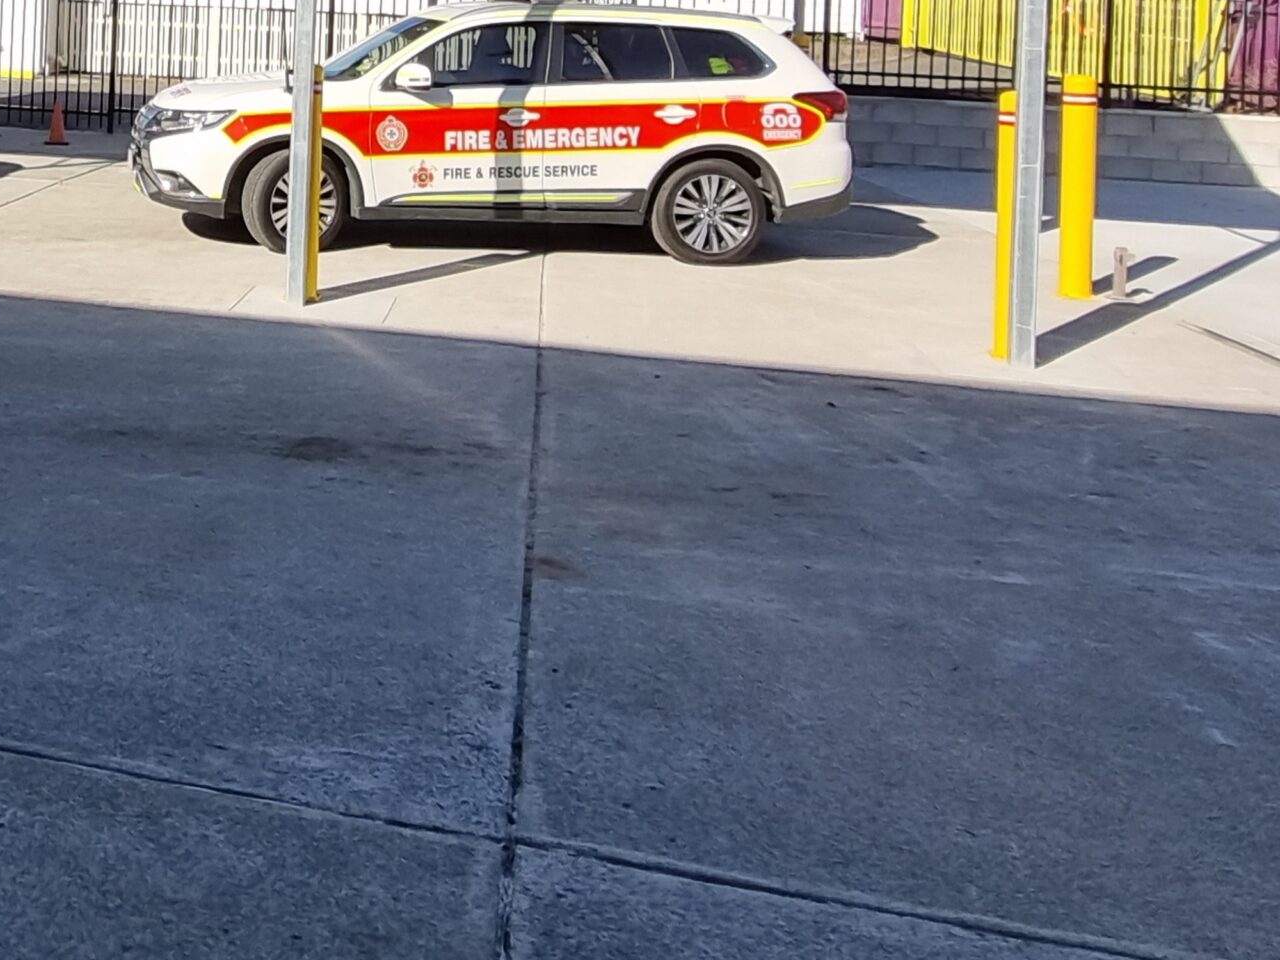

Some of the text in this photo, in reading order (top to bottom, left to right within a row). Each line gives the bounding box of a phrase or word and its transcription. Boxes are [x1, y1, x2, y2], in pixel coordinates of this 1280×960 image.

[761, 114, 801, 129] 000
[444, 126, 641, 151] FIRE & EMERGENCY
[443, 164, 598, 180] FIRE & RESCUE SERVICE
